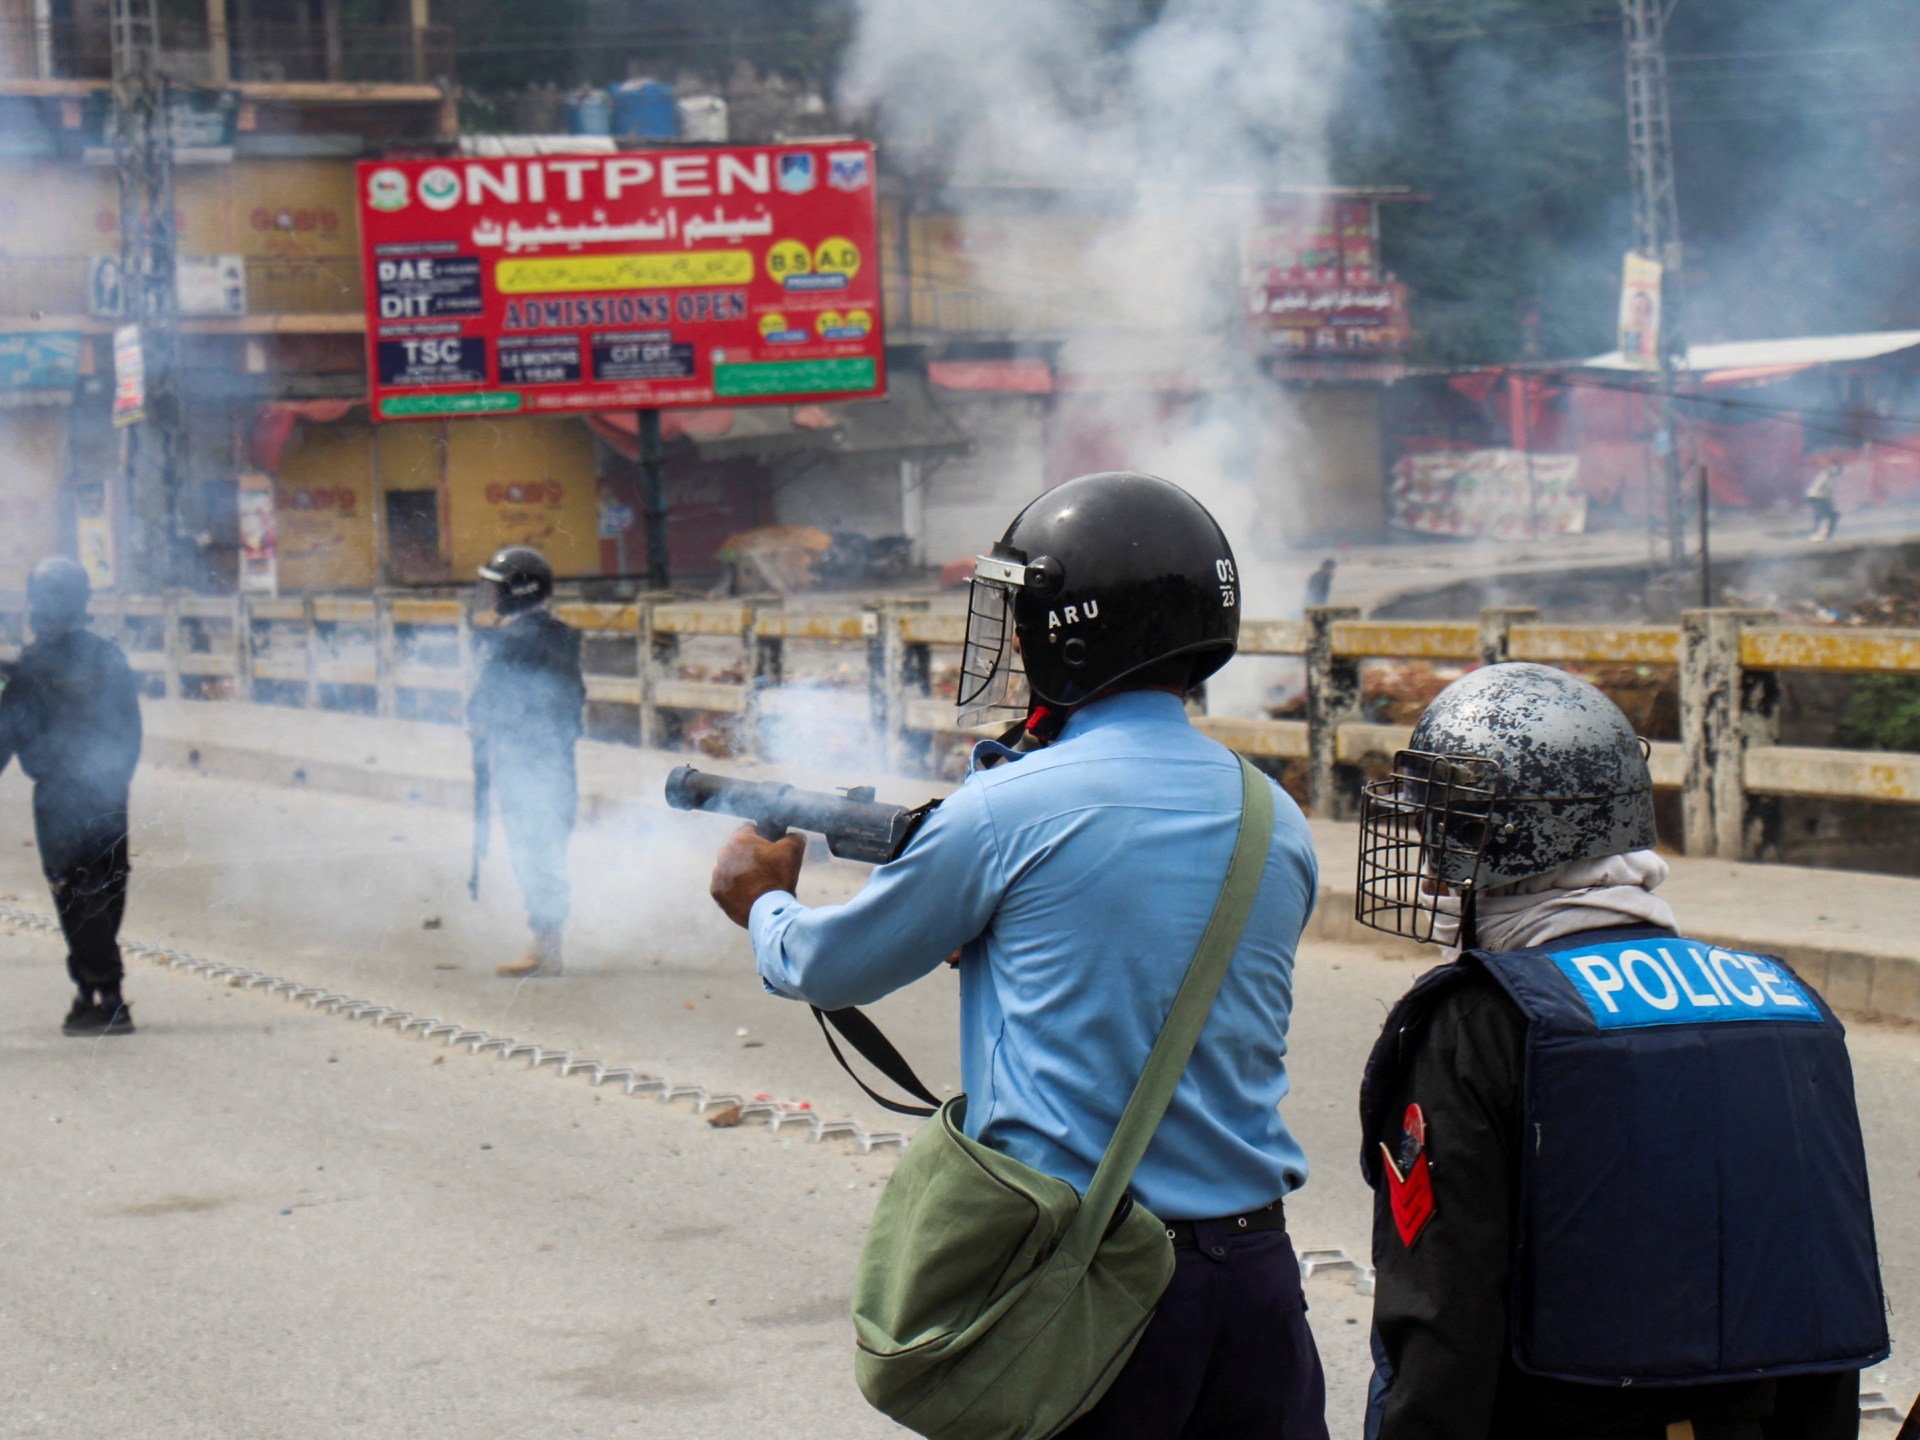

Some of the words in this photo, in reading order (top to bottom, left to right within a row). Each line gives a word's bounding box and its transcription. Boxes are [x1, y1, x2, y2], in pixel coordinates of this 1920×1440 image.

[466, 156, 770, 204] NITPEN
[379, 260, 433, 280] DAE
[381, 295, 431, 317] DIT
[505, 296, 670, 328] ADMISSIONS
[678, 293, 745, 320] OPEN
[402, 340, 461, 364] TSC
[1216, 559, 1234, 582] 03
[1222, 591, 1234, 607] 23
[1049, 600, 1099, 629] ARU
[1570, 948, 1801, 1013] POLICE
